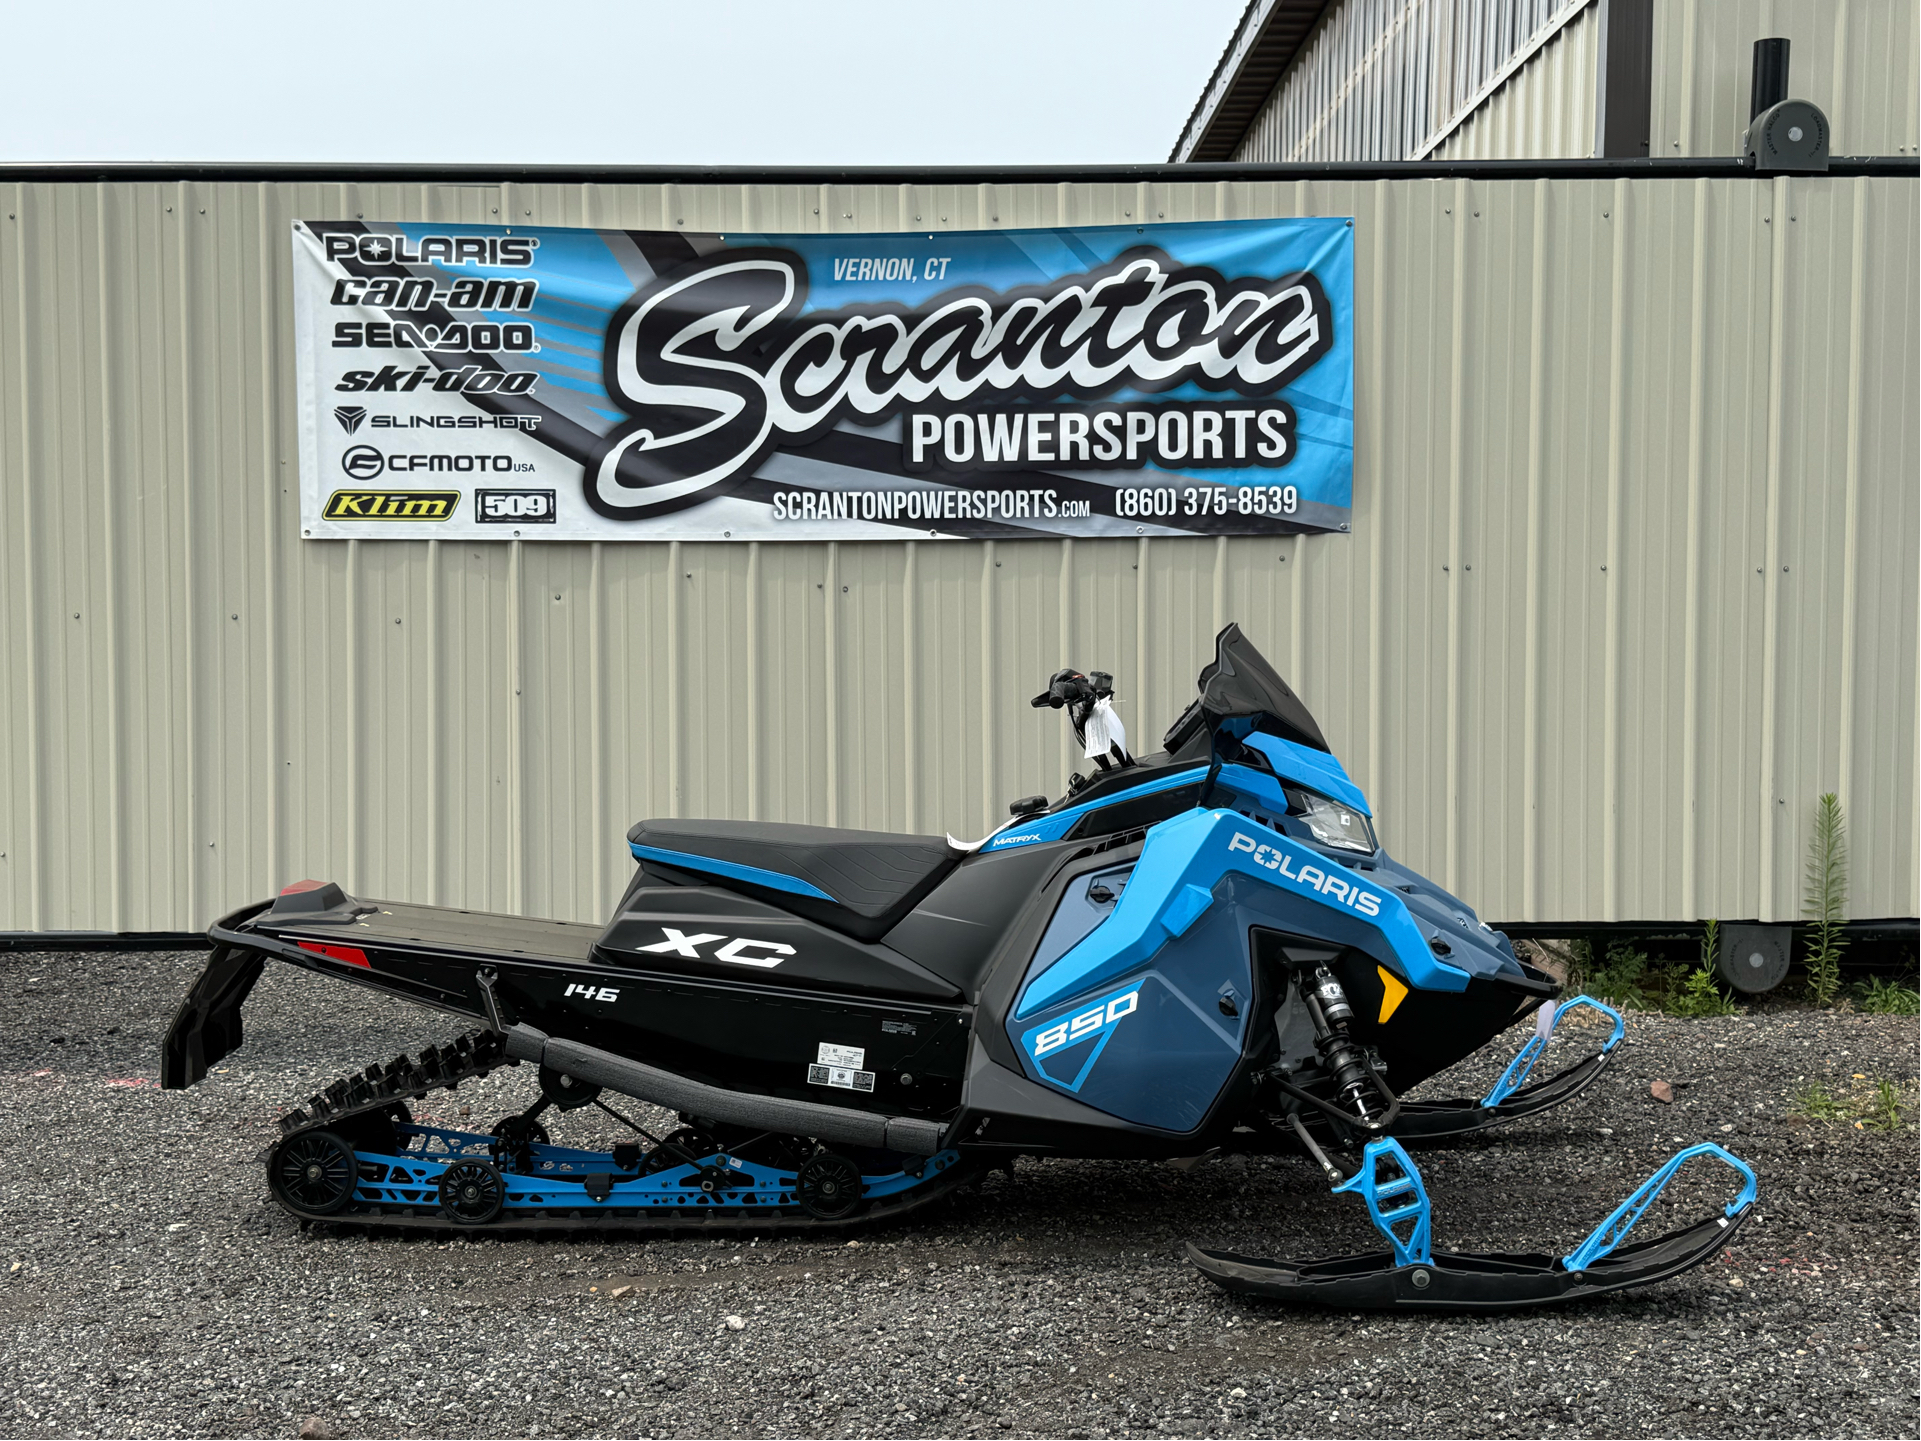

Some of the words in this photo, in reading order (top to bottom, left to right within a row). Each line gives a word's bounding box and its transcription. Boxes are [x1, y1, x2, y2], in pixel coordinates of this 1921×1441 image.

[323, 234, 540, 267] POLARIS
[834, 258, 918, 283] VERNON,
[923, 257, 952, 281] CT
[334, 365, 539, 395] ski-doo
[597, 258, 1319, 507] Scranton
[371, 415, 541, 430] SLINGSHOT
[912, 409, 1287, 463] POWERSPORTS
[388, 455, 512, 472] CFMOTO
[513, 463, 536, 473] USA
[485, 495, 548, 516] 509
[1115, 487, 1177, 517] (860)
[1184, 485, 1298, 516] 375-8539
[993, 833, 1042, 847] MATRYX
[1228, 832, 1382, 917] POLARIS
[635, 927, 797, 968] XC
[564, 983, 620, 1003] 146
[1034, 990, 1138, 1056] 850
